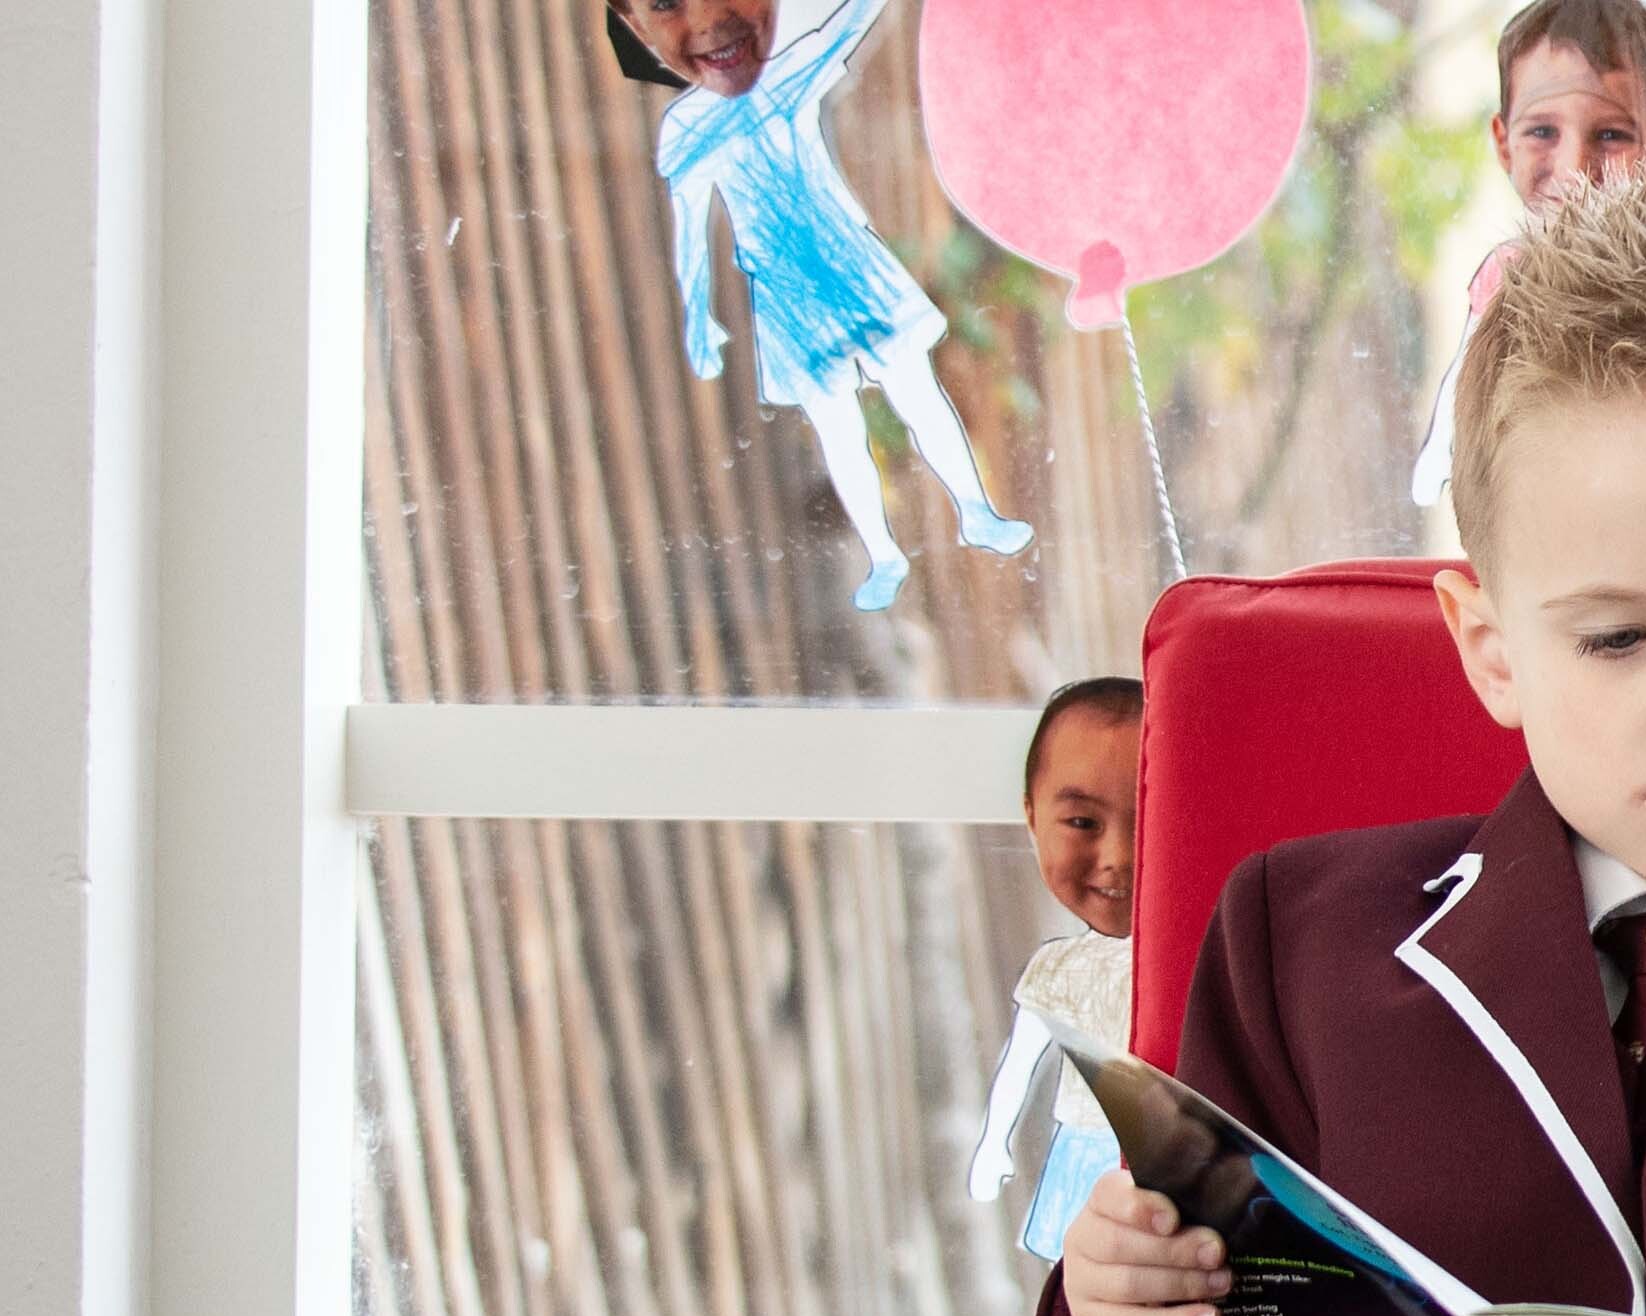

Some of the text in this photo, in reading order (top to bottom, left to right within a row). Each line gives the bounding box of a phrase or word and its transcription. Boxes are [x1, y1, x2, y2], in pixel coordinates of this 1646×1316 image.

[1307, 1261, 1355, 1278] Reading
[1262, 1273, 1290, 1283] might
[1242, 1304, 1279, 1314] Surfing
